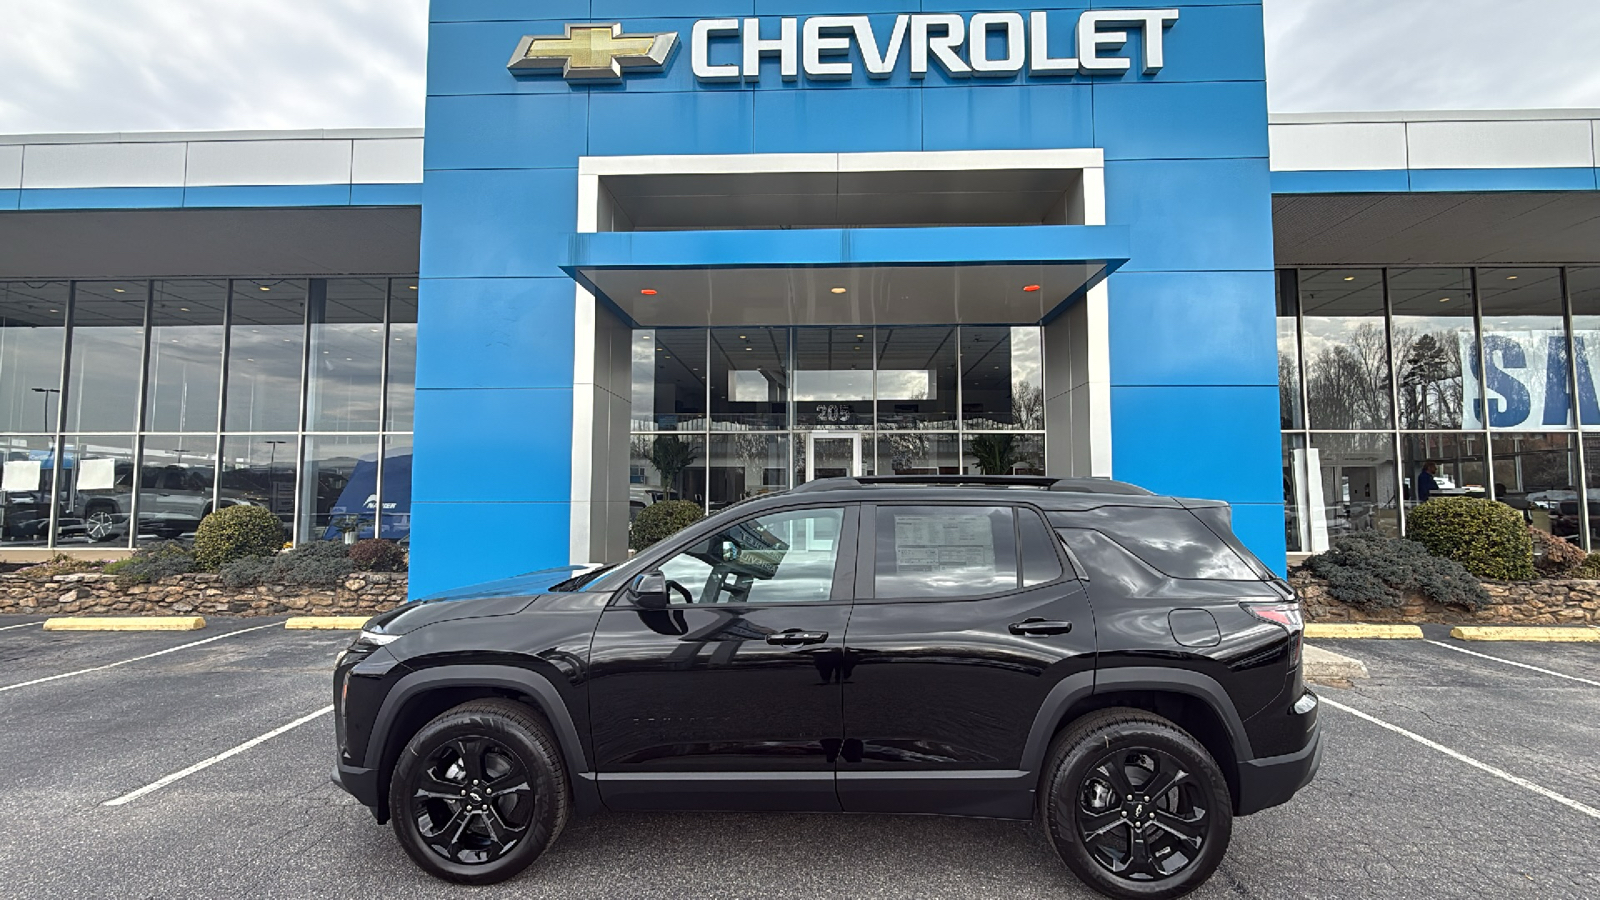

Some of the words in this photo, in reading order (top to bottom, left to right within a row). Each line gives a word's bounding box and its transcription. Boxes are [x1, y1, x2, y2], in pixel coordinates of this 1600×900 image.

[691, 9, 1179, 83] CHEVROLET
[816, 404, 851, 421] 205
[1468, 334, 1600, 428] SA
